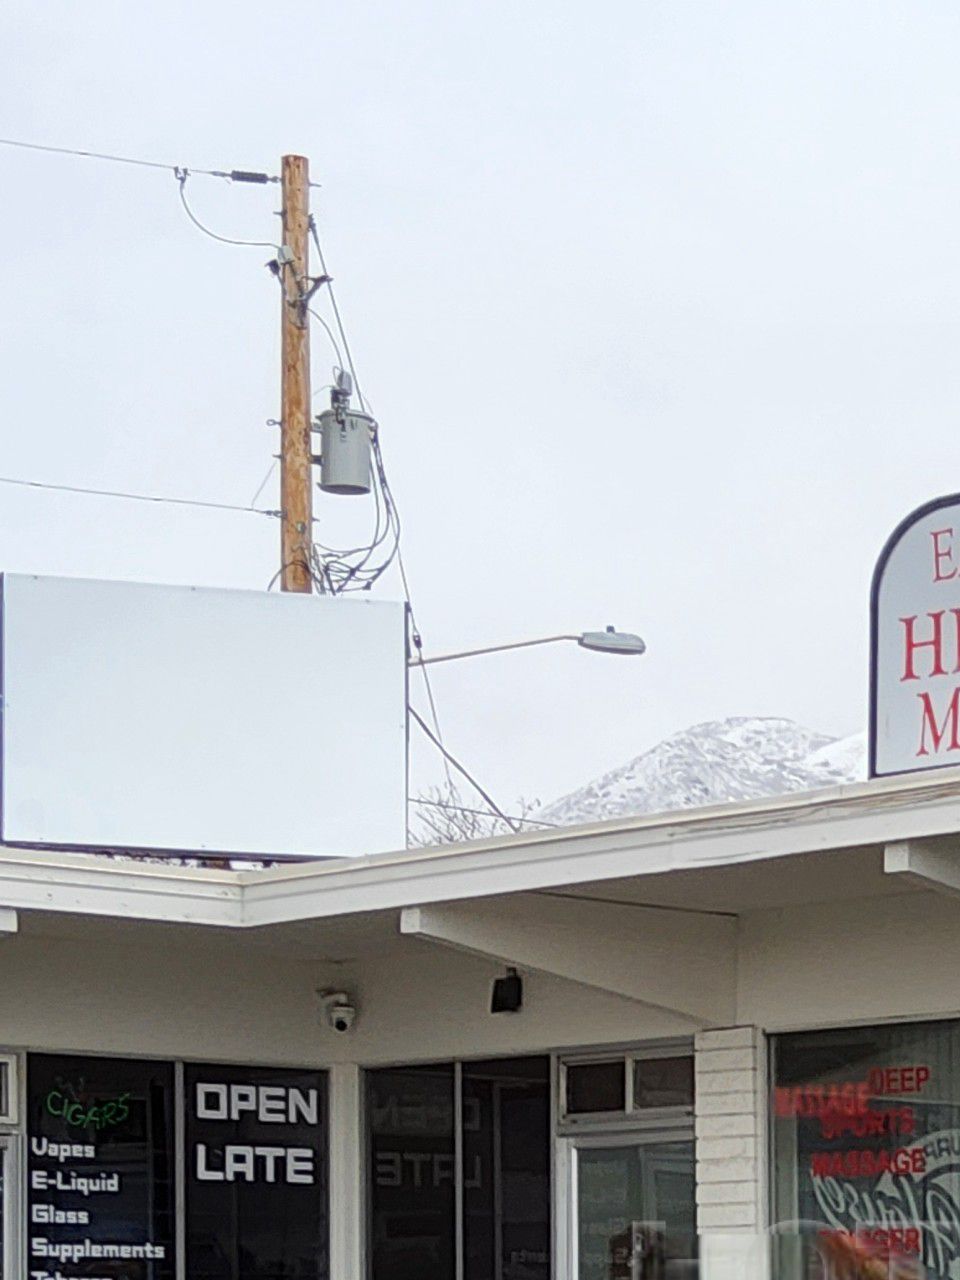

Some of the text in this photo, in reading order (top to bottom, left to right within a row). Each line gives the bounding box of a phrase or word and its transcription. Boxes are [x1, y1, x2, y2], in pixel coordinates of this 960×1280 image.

[869, 1065, 930, 1096] DEEP
[46, 1090, 131, 1130] CIGARS
[195, 1082, 318, 1125] OPEN
[31, 1136, 96, 1162] Vapes
[195, 1144, 315, 1185] LATE
[811, 1146, 927, 1180] MASSAGE
[31, 1170, 120, 1196] E-Liquid
[31, 1203, 90, 1224] Glass
[31, 1237, 166, 1264] Supplements
